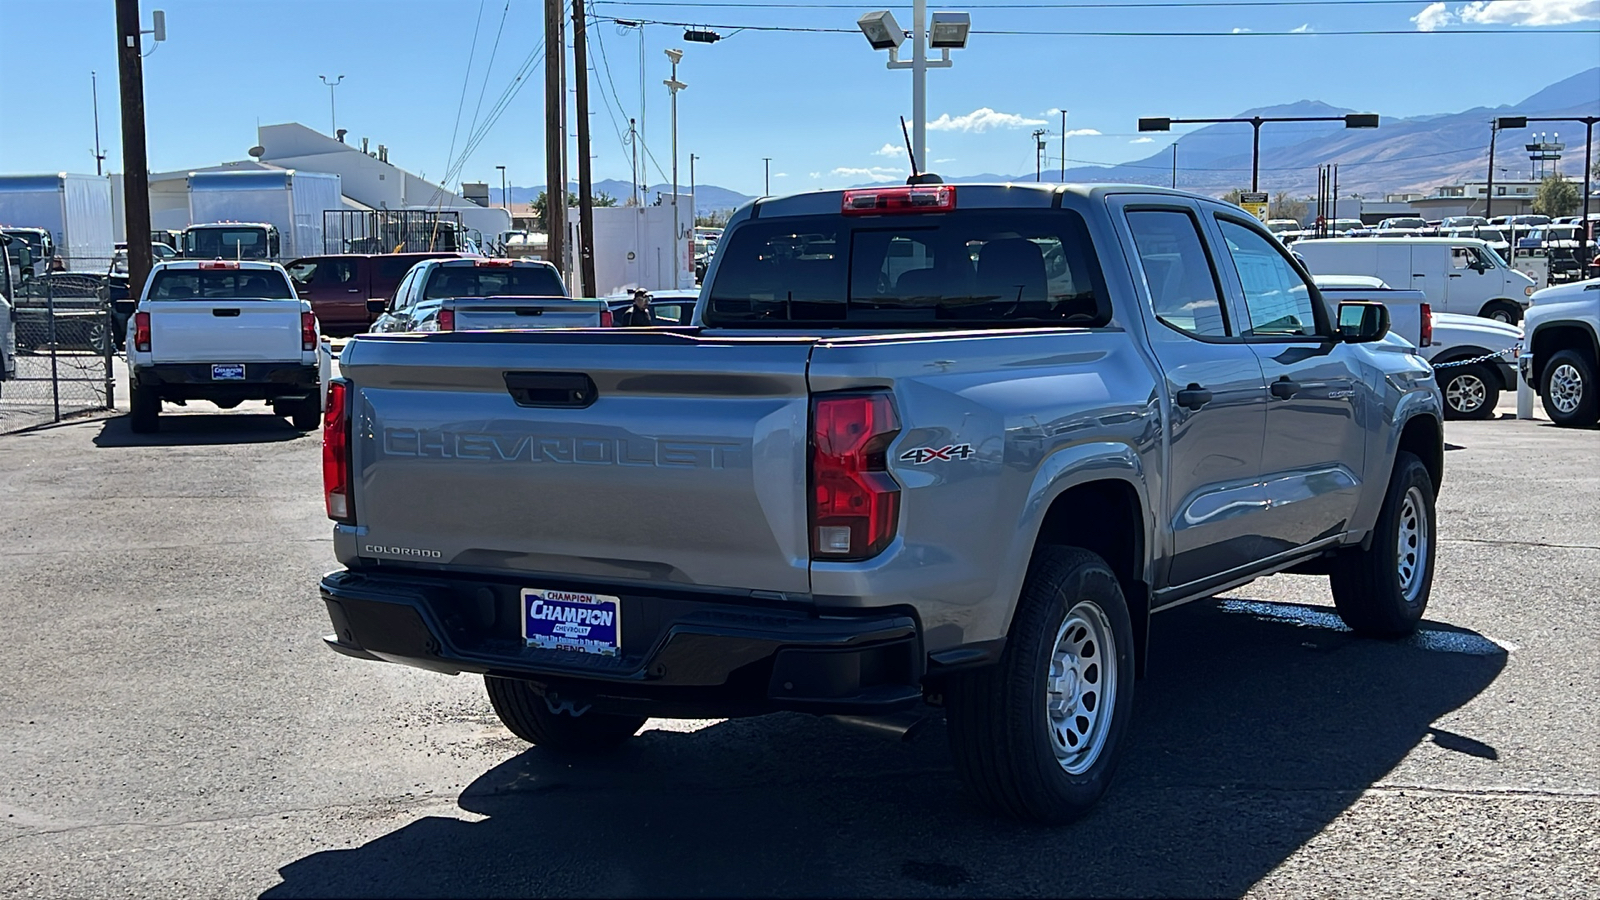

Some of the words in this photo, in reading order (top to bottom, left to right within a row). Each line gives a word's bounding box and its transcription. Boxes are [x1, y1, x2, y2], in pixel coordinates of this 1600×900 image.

[383, 426, 742, 470] CHEVROLET
[365, 544, 442, 558] COLORADO
[547, 591, 593, 603] CHAMPION
[530, 600, 613, 626] CHAMPION
[555, 625, 588, 634] CHEVROLET
[556, 644, 586, 653] RENO
